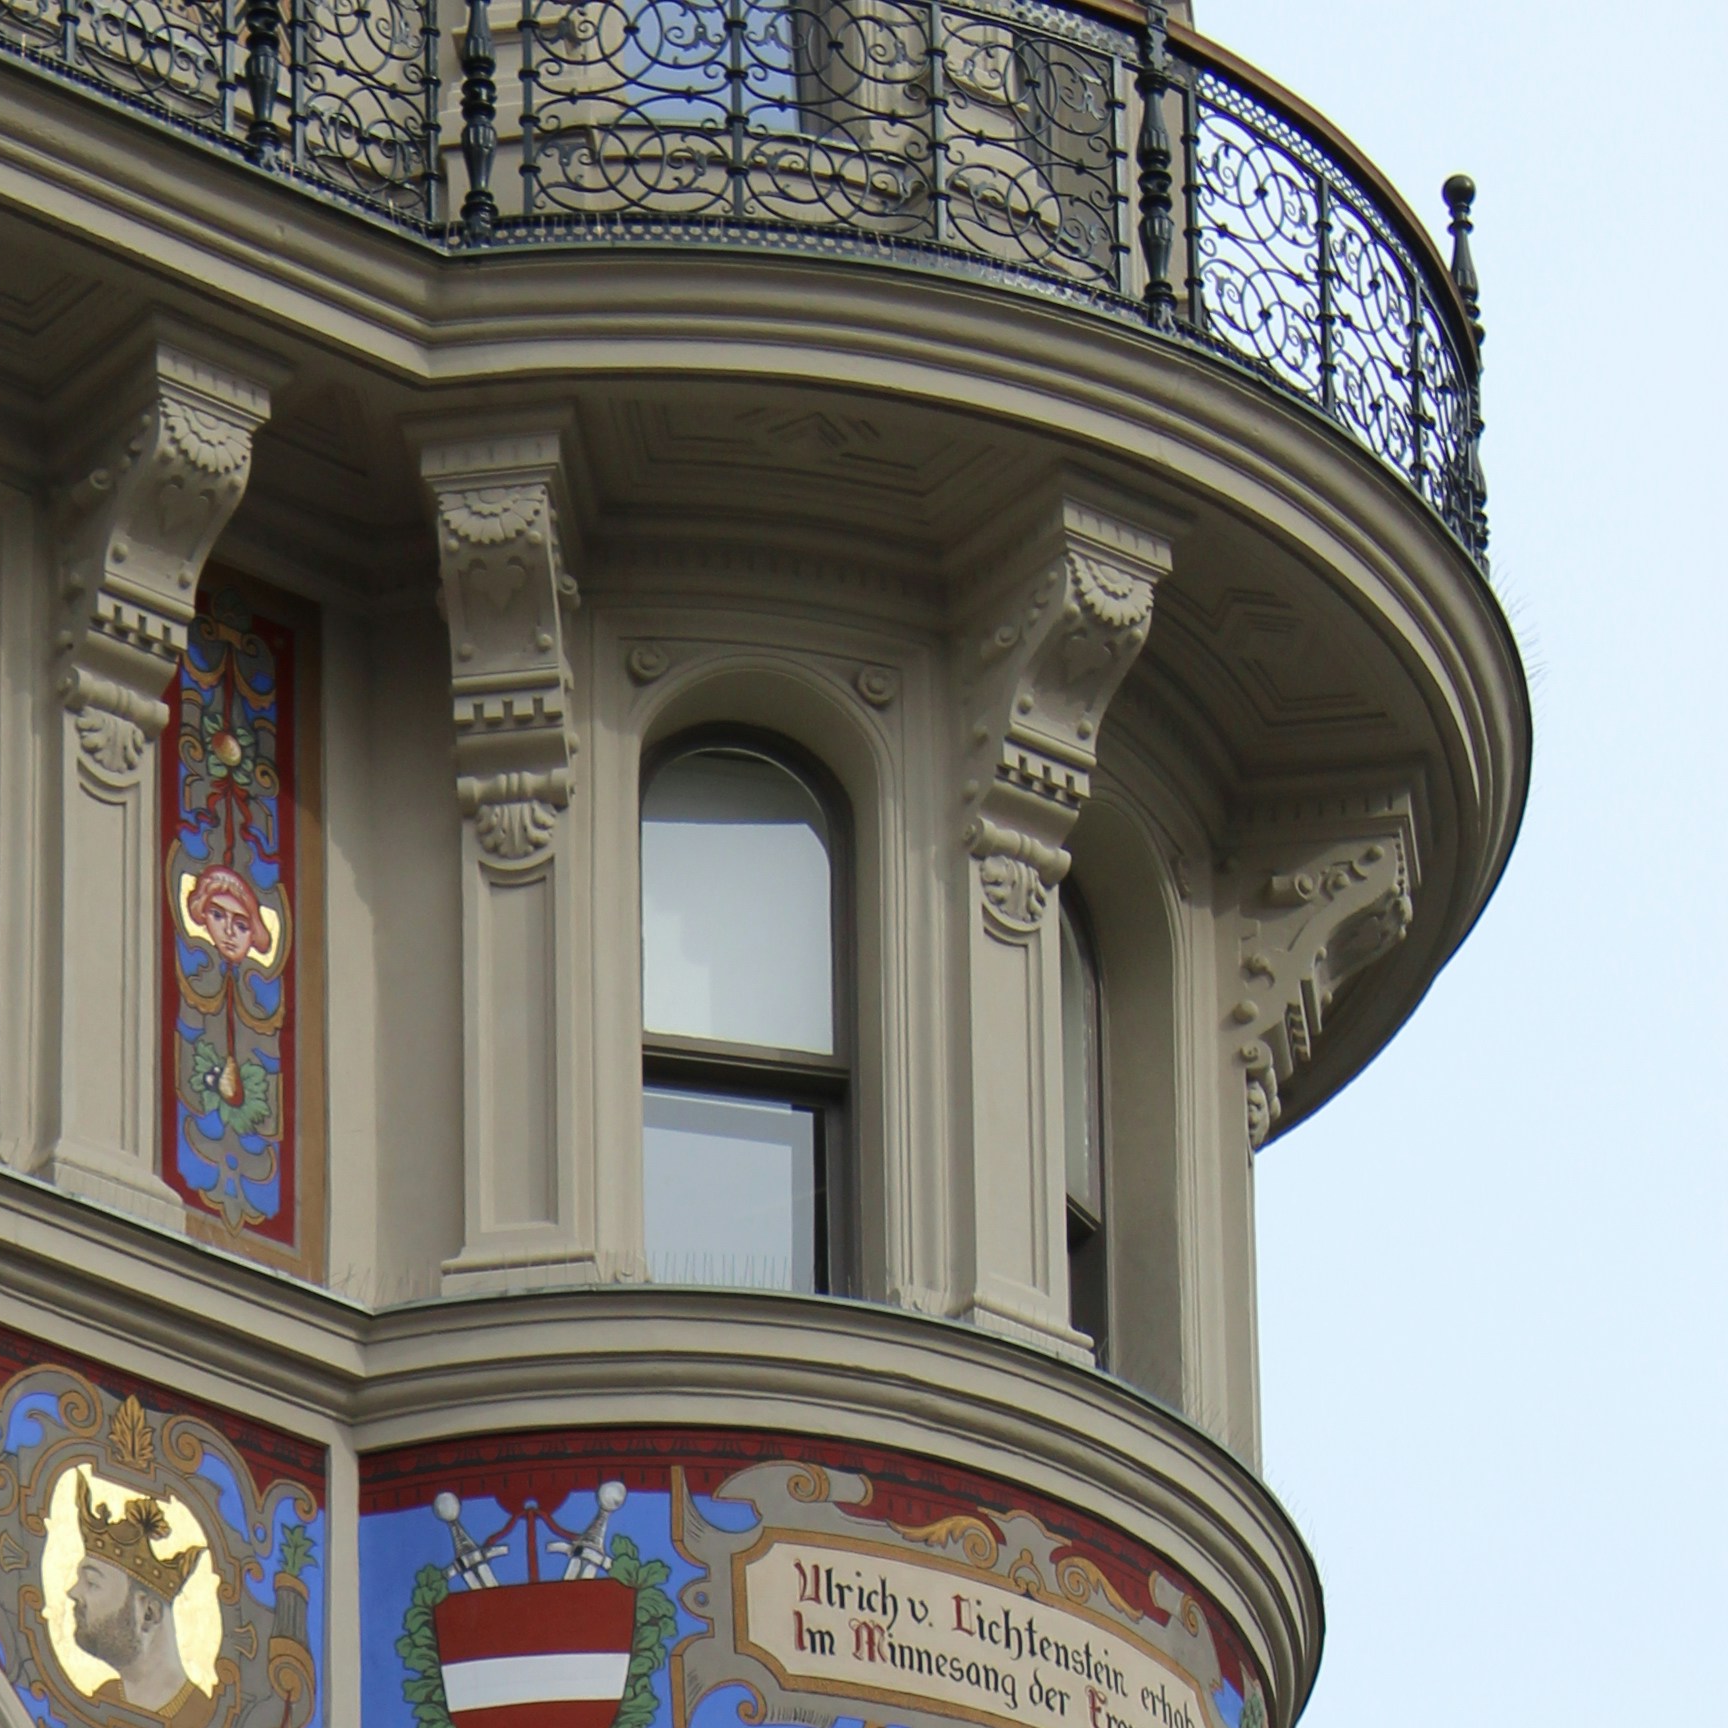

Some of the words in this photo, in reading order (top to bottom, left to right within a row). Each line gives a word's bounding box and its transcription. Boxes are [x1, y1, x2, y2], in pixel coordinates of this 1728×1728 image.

[792, 1558, 899, 1632] Ulrich
[906, 1596, 934, 1628] v.
[950, 1593, 1128, 1698] Lichtenstein
[792, 1609, 836, 1656] Im
[848, 1617, 1019, 1711] Minnesang
[1028, 1667, 1071, 1716] der
